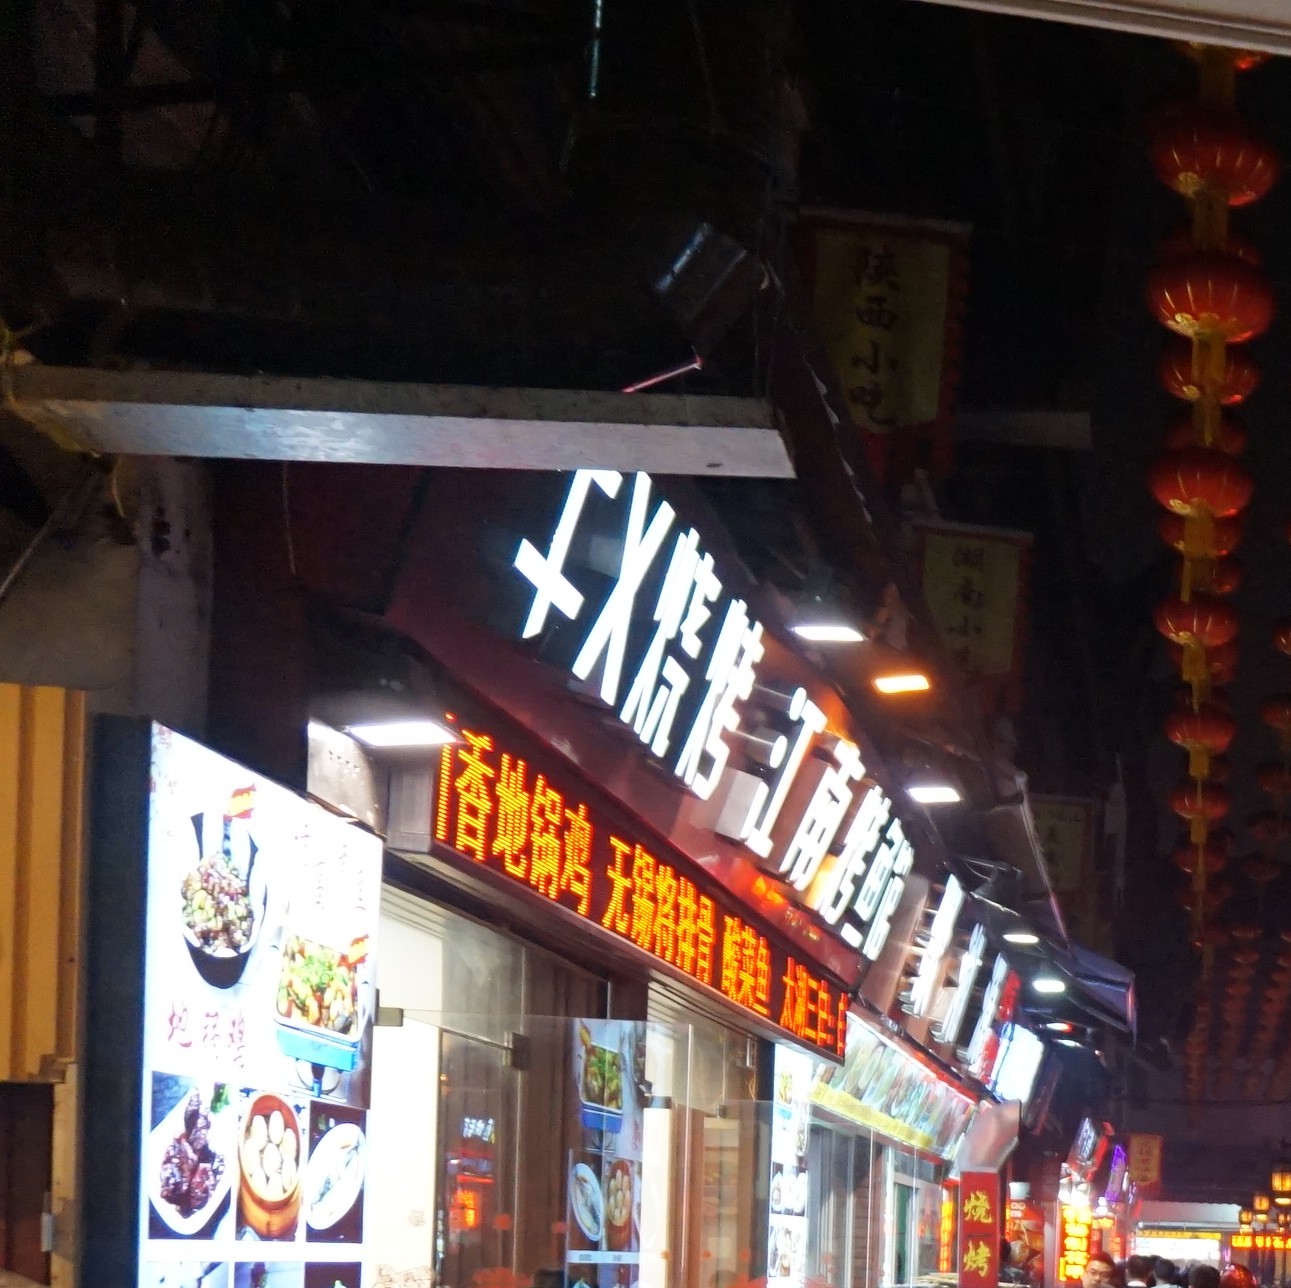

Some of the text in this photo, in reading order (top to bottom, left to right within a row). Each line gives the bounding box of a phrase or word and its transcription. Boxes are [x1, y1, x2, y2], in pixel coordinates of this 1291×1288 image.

[436, 729, 594, 917] 香地锅鸡
[963, 1190, 993, 1278] 烧烤
